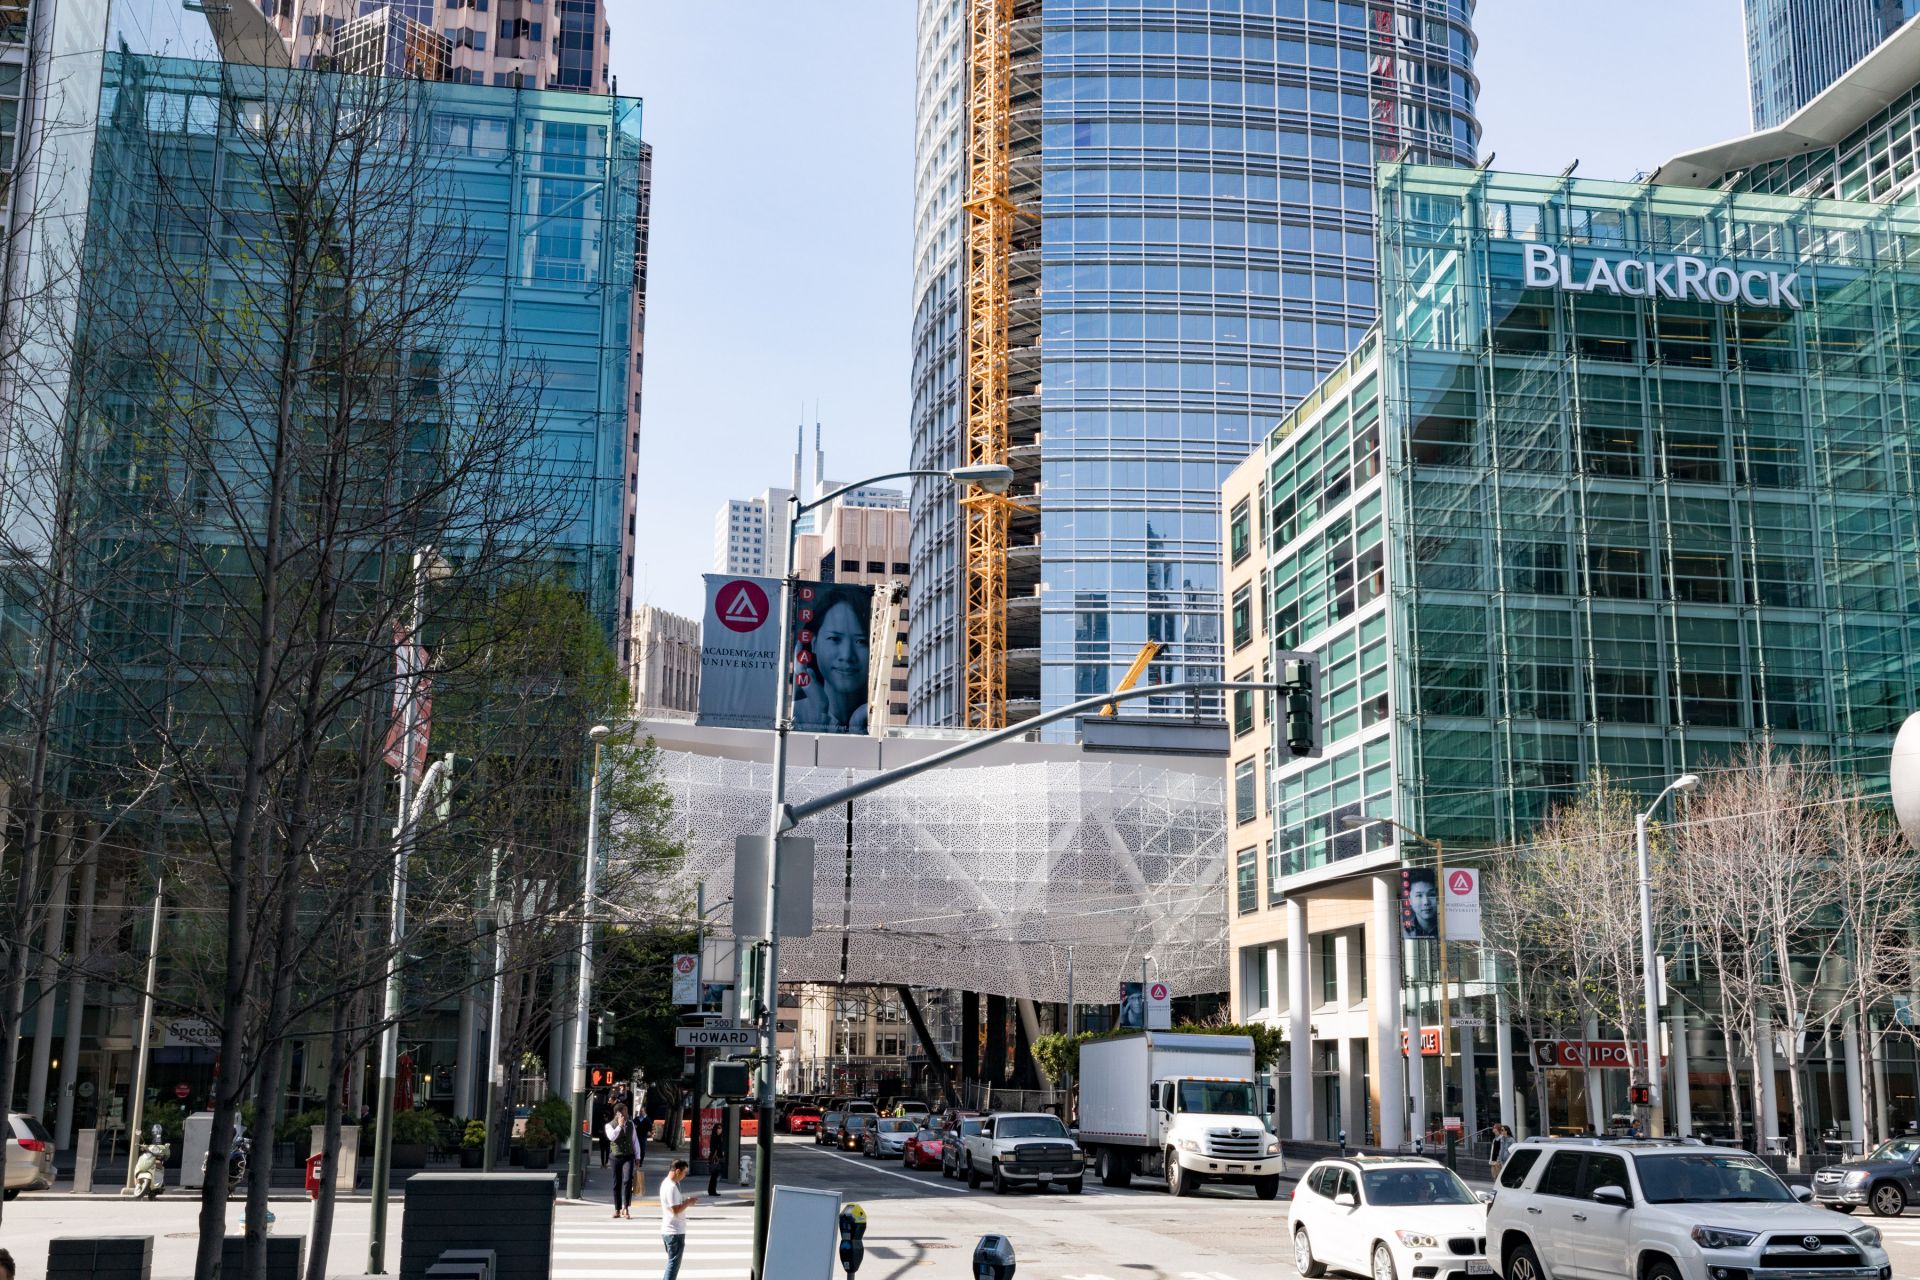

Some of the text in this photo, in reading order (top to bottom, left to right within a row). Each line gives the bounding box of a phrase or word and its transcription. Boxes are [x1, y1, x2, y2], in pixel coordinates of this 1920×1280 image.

[798, 589, 812, 685] DREAM
[703, 658, 776, 669] UNIVERSITY
[714, 1020, 729, 1028] 500
[689, 1032, 748, 1043] HOWARD
